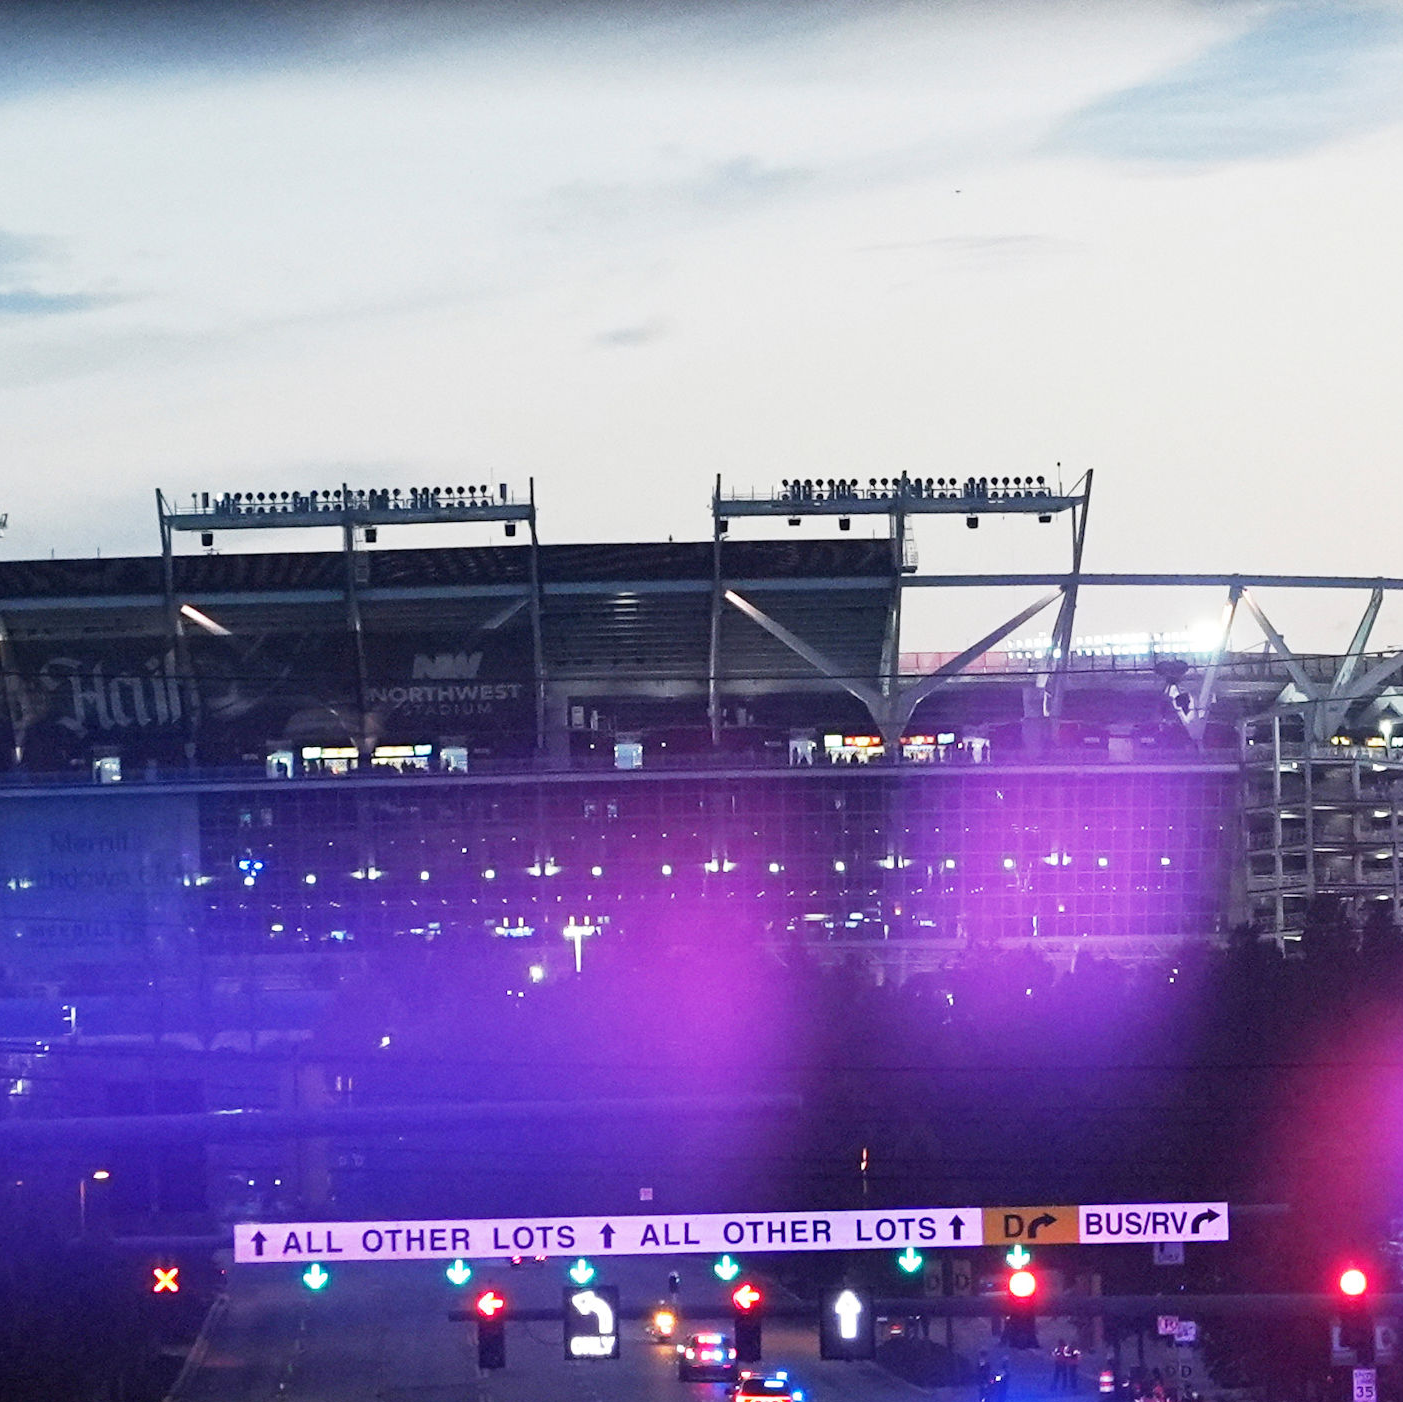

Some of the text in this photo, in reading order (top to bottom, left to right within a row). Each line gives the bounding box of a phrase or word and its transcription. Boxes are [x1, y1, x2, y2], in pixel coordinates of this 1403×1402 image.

[40, 647, 183, 739] Hail
[368, 683, 524, 703] NORTHWEST
[401, 703, 493, 717] STADIUM
[282, 1216, 937, 1254] ALL OTHER LOTS ALL OTHER LOTS
[1004, 1214, 1023, 1238] D
[1085, 1212, 1188, 1236] BUS/RV
[570, 1335, 616, 1357] ONLY
[1355, 1386, 1374, 1399] 35
